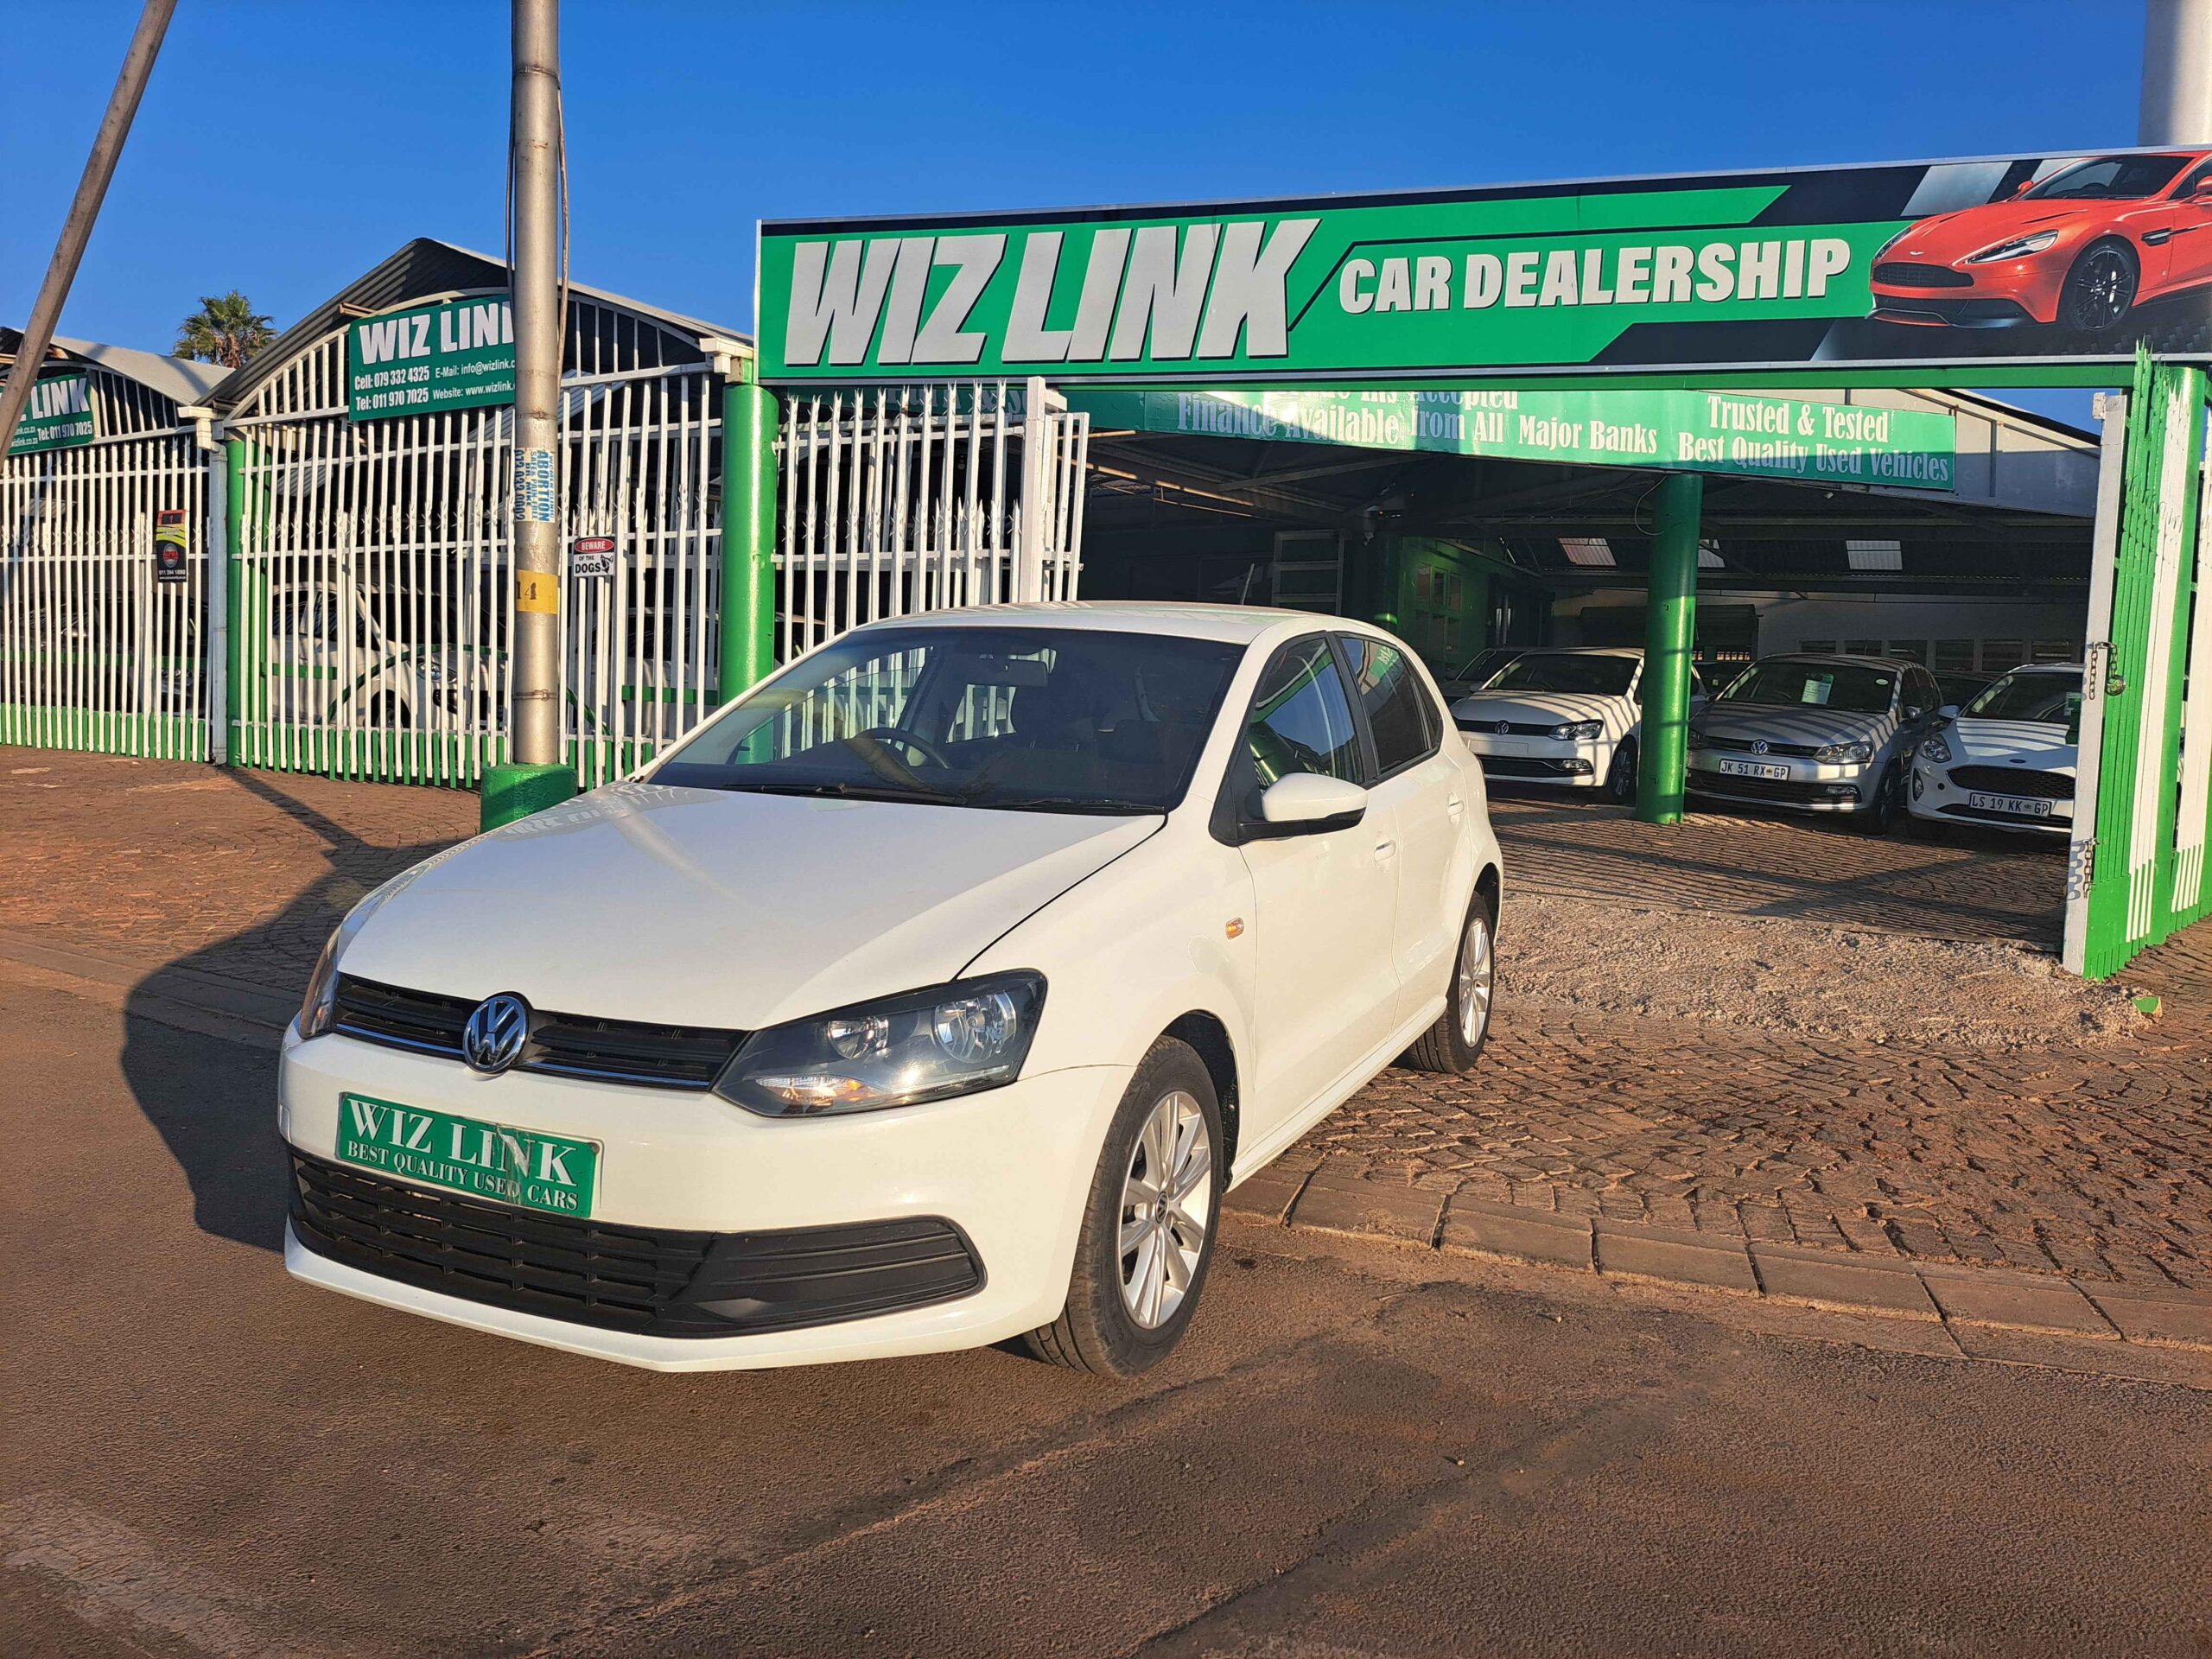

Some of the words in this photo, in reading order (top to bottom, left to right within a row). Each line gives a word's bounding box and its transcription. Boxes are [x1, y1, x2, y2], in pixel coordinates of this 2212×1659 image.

[785, 233, 1008, 365] WIZ
[1001, 218, 1322, 364] LINK
[1339, 255, 1452, 315] CAR
[1464, 238, 1851, 309] DEALERSHIP
[359, 314, 431, 365] WIZ
[354, 374, 373, 391] Cell:
[374, 372, 389, 388] 079
[390, 369, 406, 385] 332
[407, 365, 429, 383] 4325
[435, 365, 460, 378] E-Mail:
[461, 359, 516, 375] info@wizlink.c
[30, 378, 90, 419] LINK
[355, 395, 372, 411] Tel:
[372, 392, 388, 409] 011
[389, 390, 404, 407] 970
[407, 387, 429, 404] 7025
[433, 387, 464, 400] Website:
[465, 380, 515, 397] www.wizlink.
[49, 425, 61, 440] 011
[61, 423, 75, 438] 970
[75, 421, 92, 435] 7025
[1177, 392, 1277, 435] Finance
[1285, 404, 1399, 445] Available
[1473, 411, 1503, 442] All
[1518, 414, 1583, 450] Major
[1590, 420, 1657, 454] Banks
[1707, 394, 1789, 435] Trusted
[1796, 404, 1815, 435] &
[1822, 406, 1889, 443] Tested
[1678, 432, 1725, 464] Best
[1732, 436, 1808, 474] Quality
[1815, 443, 1862, 474] Used
[1870, 447, 1948, 481] Vehicles
[537, 450, 550, 521] ABORTION
[582, 541, 606, 550] BEWARE
[575, 563, 601, 574] DOGS
[1721, 761, 1732, 772] JK
[1738, 764, 1749, 774] 51
[1754, 766, 1766, 776] RX
[1774, 767, 1786, 778] GP
[1972, 795, 1984, 807] LS
[1991, 797, 2003, 810] 19
[2008, 799, 2022, 811] KK
[2034, 802, 2048, 814] GP
[347, 1099, 435, 1154] WIZ
[448, 1122, 578, 1187] LINK
[347, 1140, 389, 1166] BEST
[394, 1152, 468, 1186] QUALITY
[474, 1171, 522, 1198] USED
[527, 1185, 578, 1211] CARS
